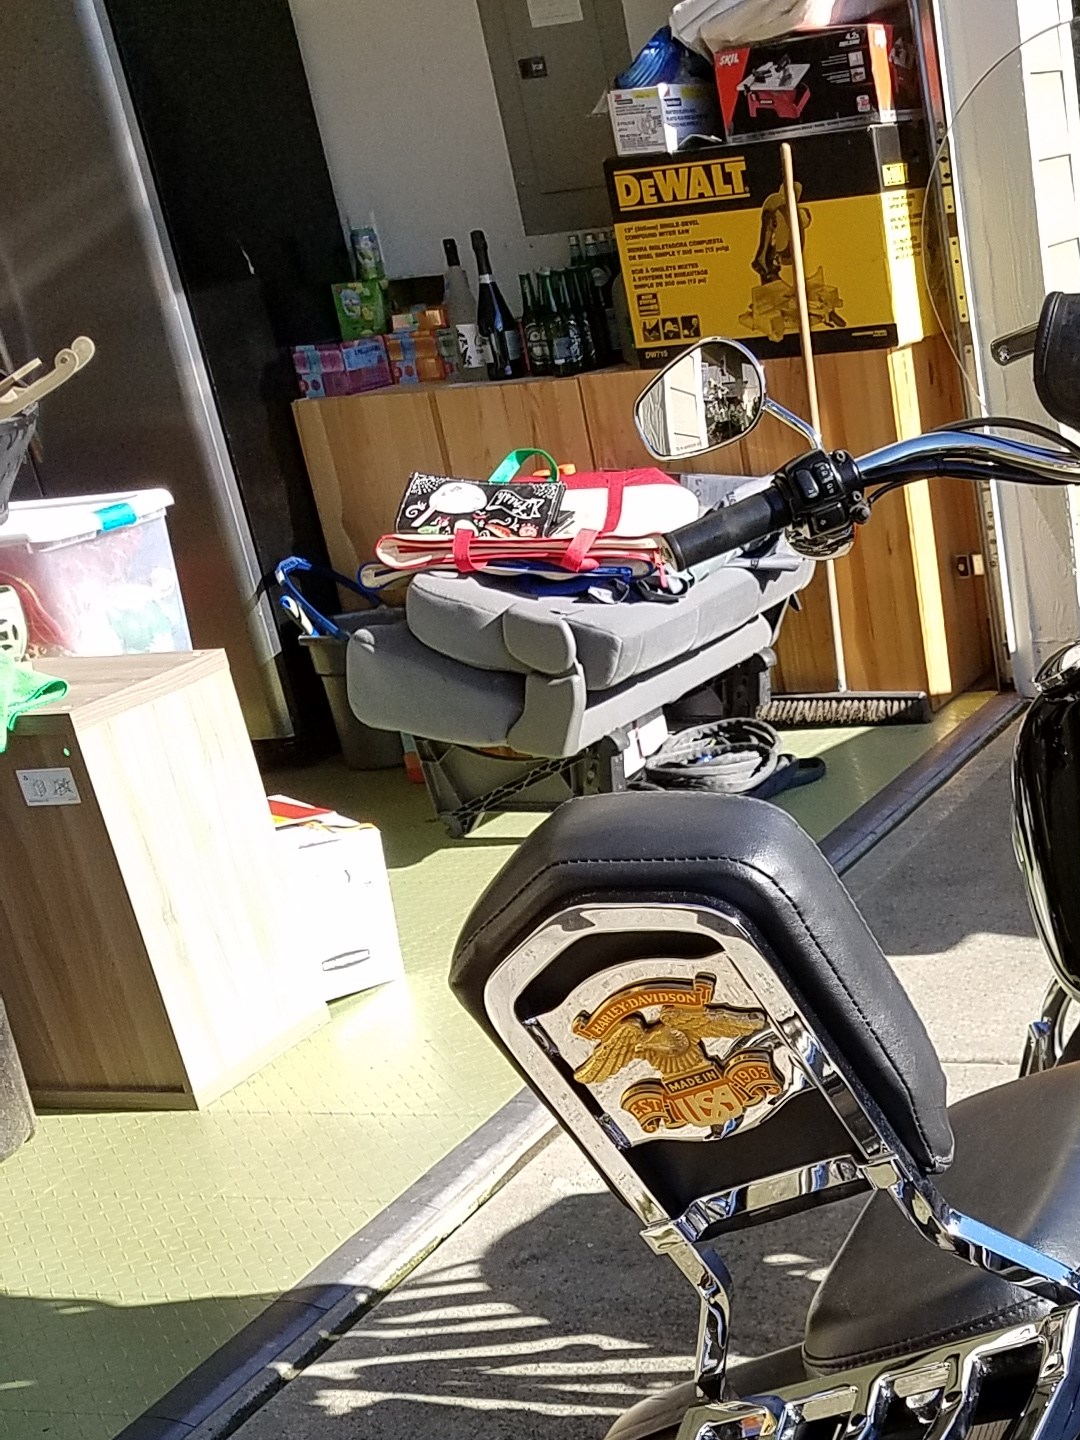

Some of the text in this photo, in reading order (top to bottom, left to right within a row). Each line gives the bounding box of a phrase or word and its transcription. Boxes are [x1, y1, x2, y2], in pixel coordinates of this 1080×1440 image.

[719, 53, 740, 67] SKIL
[615, 163, 749, 207] DEWALT
[631, 1066, 770, 1117] EST. 1903
[668, 1070, 718, 1093] MADE IN
[674, 1084, 744, 1127] USA
